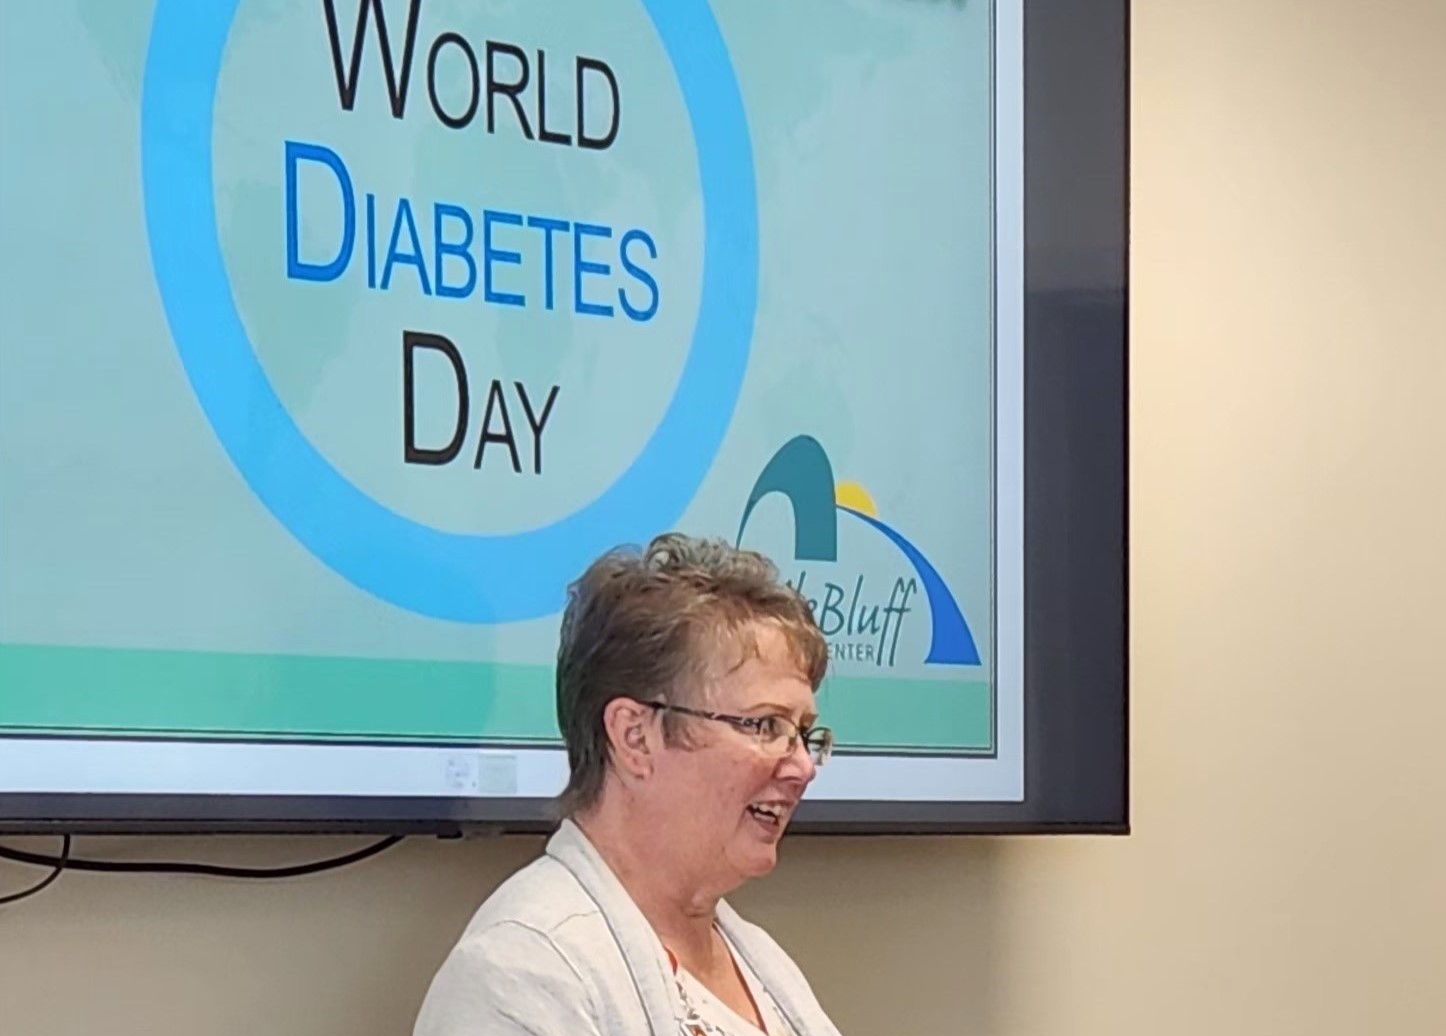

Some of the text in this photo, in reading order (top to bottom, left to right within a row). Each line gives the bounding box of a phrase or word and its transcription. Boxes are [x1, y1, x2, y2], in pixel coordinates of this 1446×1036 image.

[325, 0, 620, 150] WORLD
[285, 140, 660, 322] DIABETES
[403, 331, 560, 474] DAY
